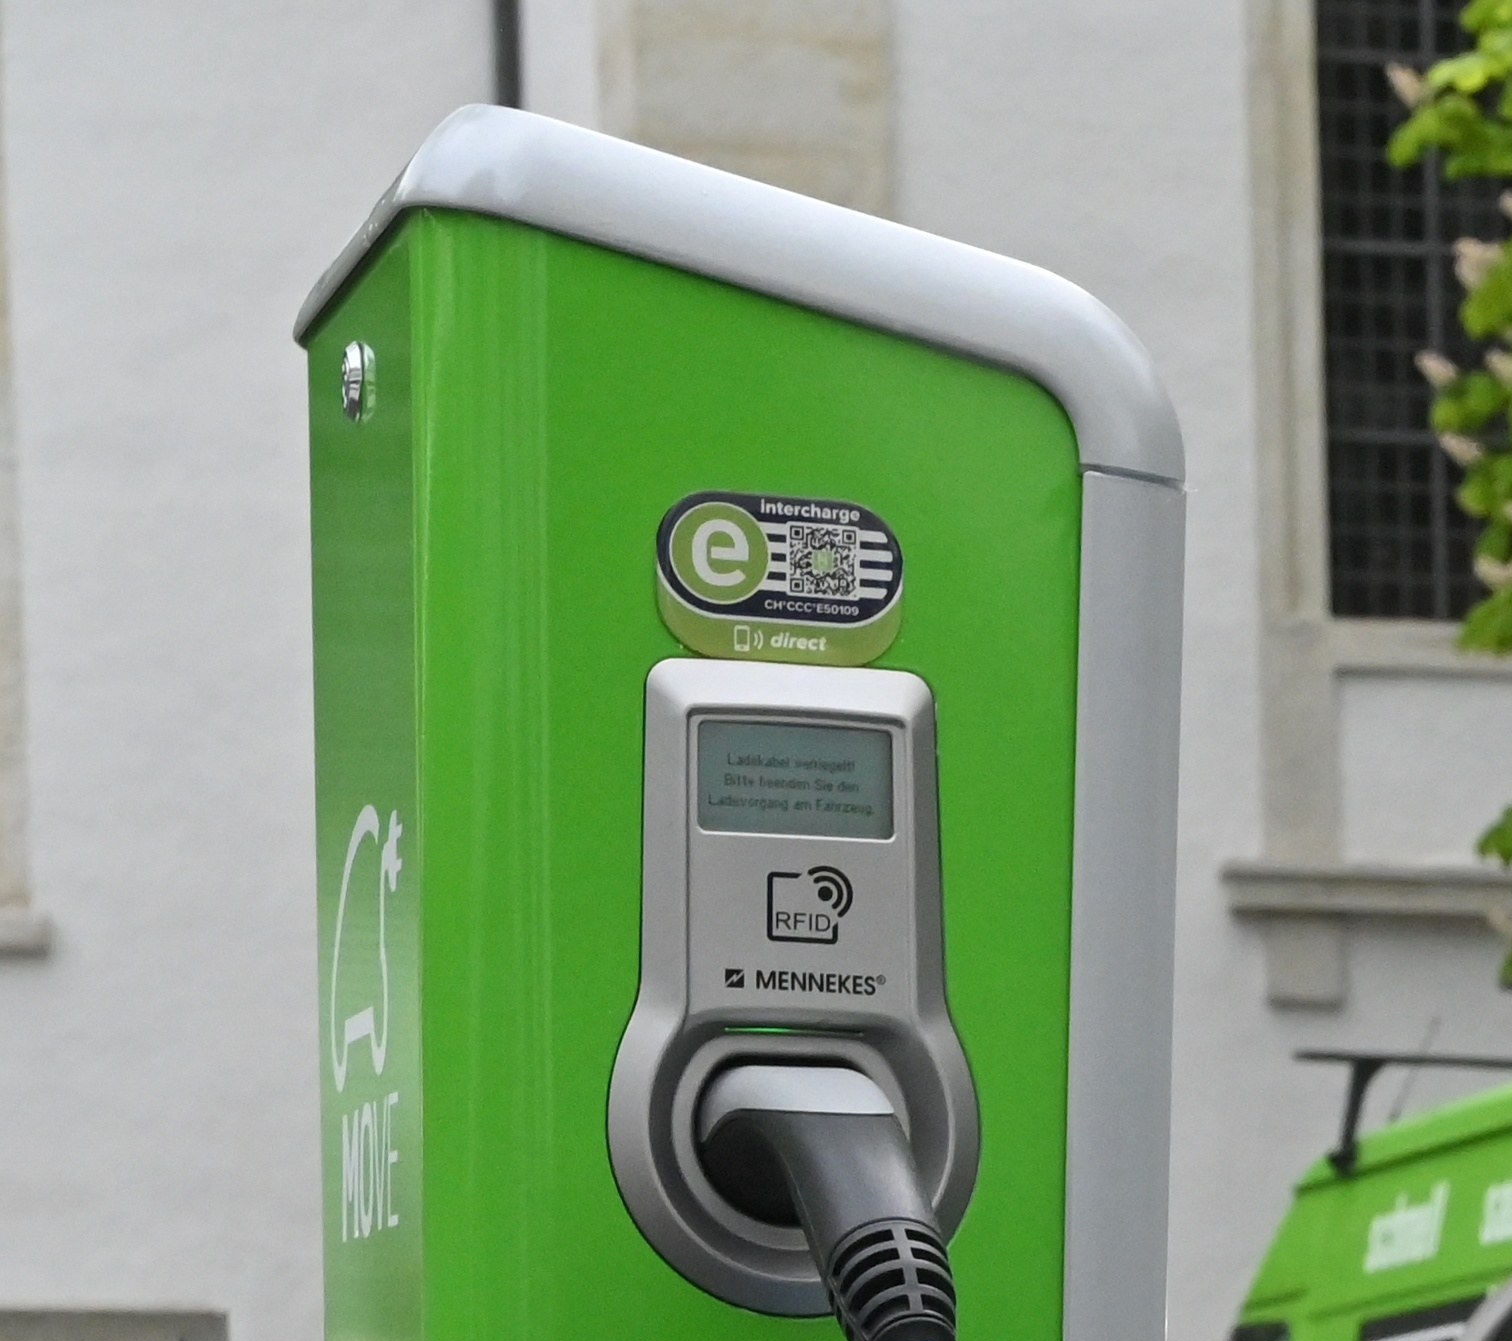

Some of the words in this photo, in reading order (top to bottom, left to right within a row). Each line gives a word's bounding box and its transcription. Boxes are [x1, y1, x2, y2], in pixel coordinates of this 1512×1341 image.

[759, 498, 861, 524] intercharge
[690, 518, 750, 587] e
[770, 631, 827, 652] direct
[728, 753, 790, 767] Ladekabel
[723, 774, 755, 788] Bitte
[758, 775, 811, 791] beenden
[814, 778, 834, 792] Sie
[837, 779, 860, 793] den
[708, 794, 789, 812] Ladevorgang
[793, 800, 811, 812] am
[774, 911, 831, 933] RFID
[341, 1091, 399, 1243] MOVE
